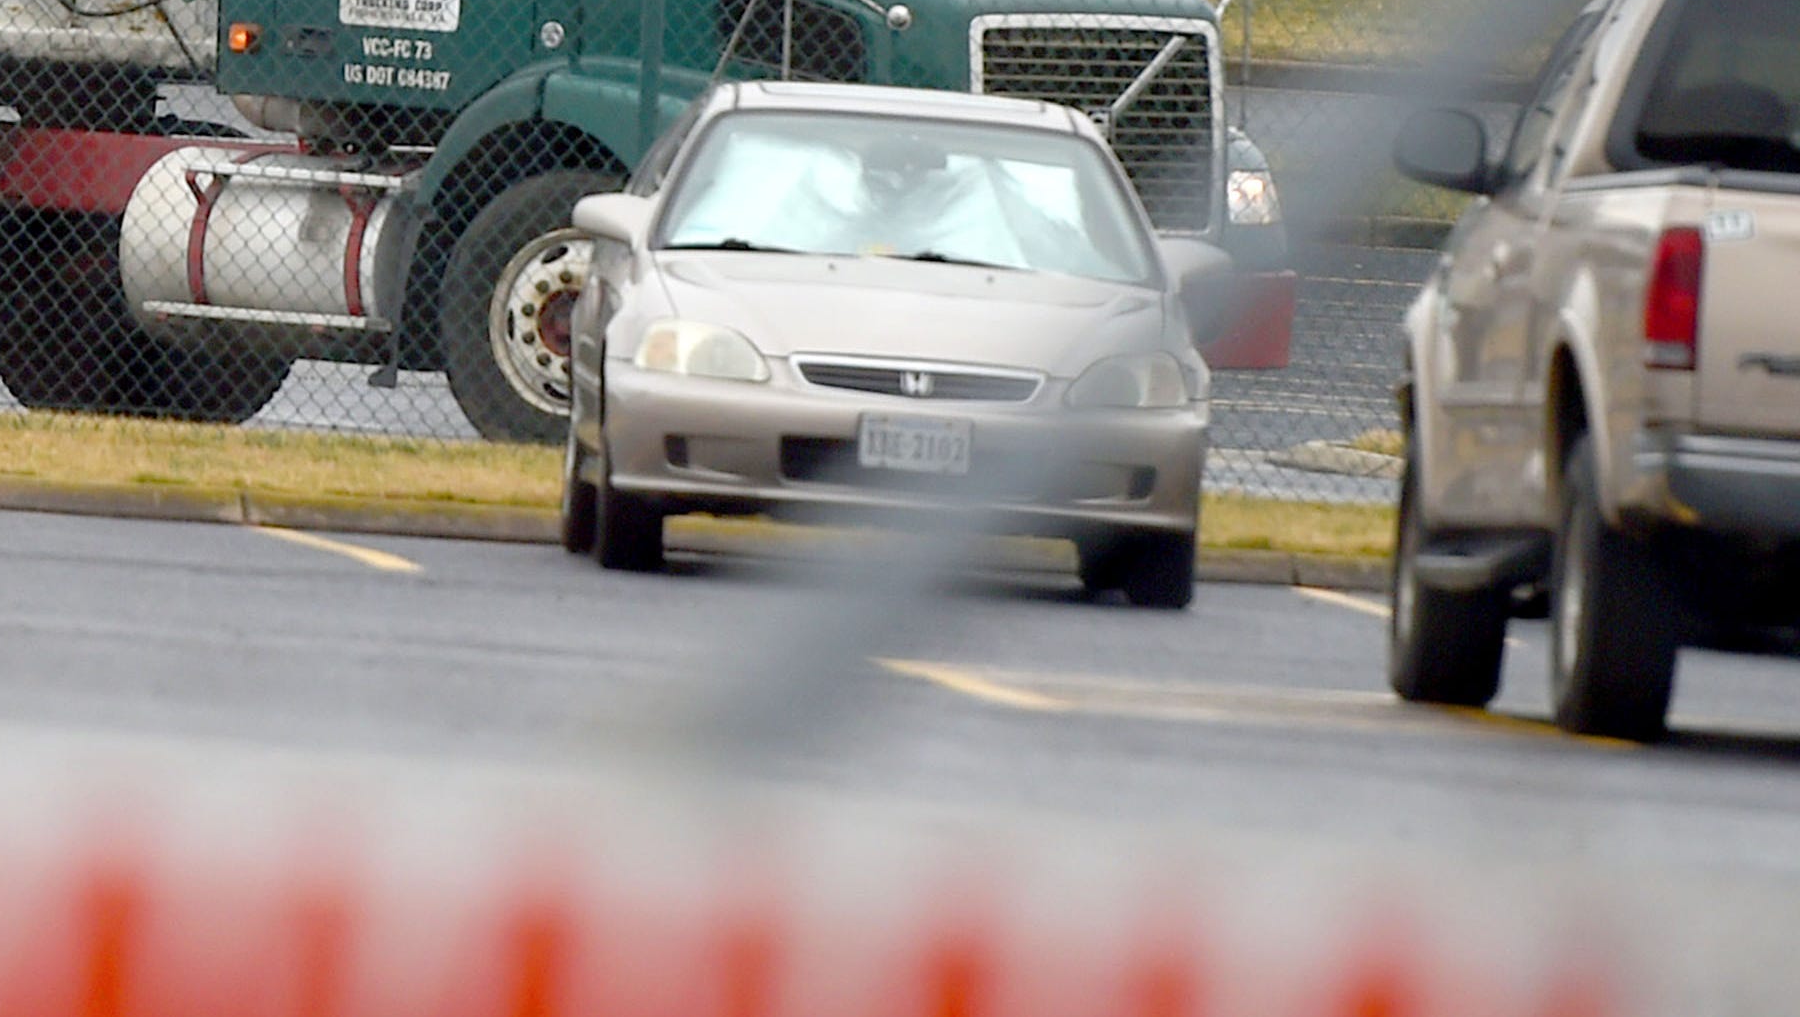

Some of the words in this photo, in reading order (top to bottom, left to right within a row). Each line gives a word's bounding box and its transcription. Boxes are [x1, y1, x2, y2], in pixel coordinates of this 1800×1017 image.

[362, 36, 411, 58] VCC-FC
[414, 39, 432, 60] 73
[344, 63, 363, 84] US
[366, 65, 395, 86] DOT
